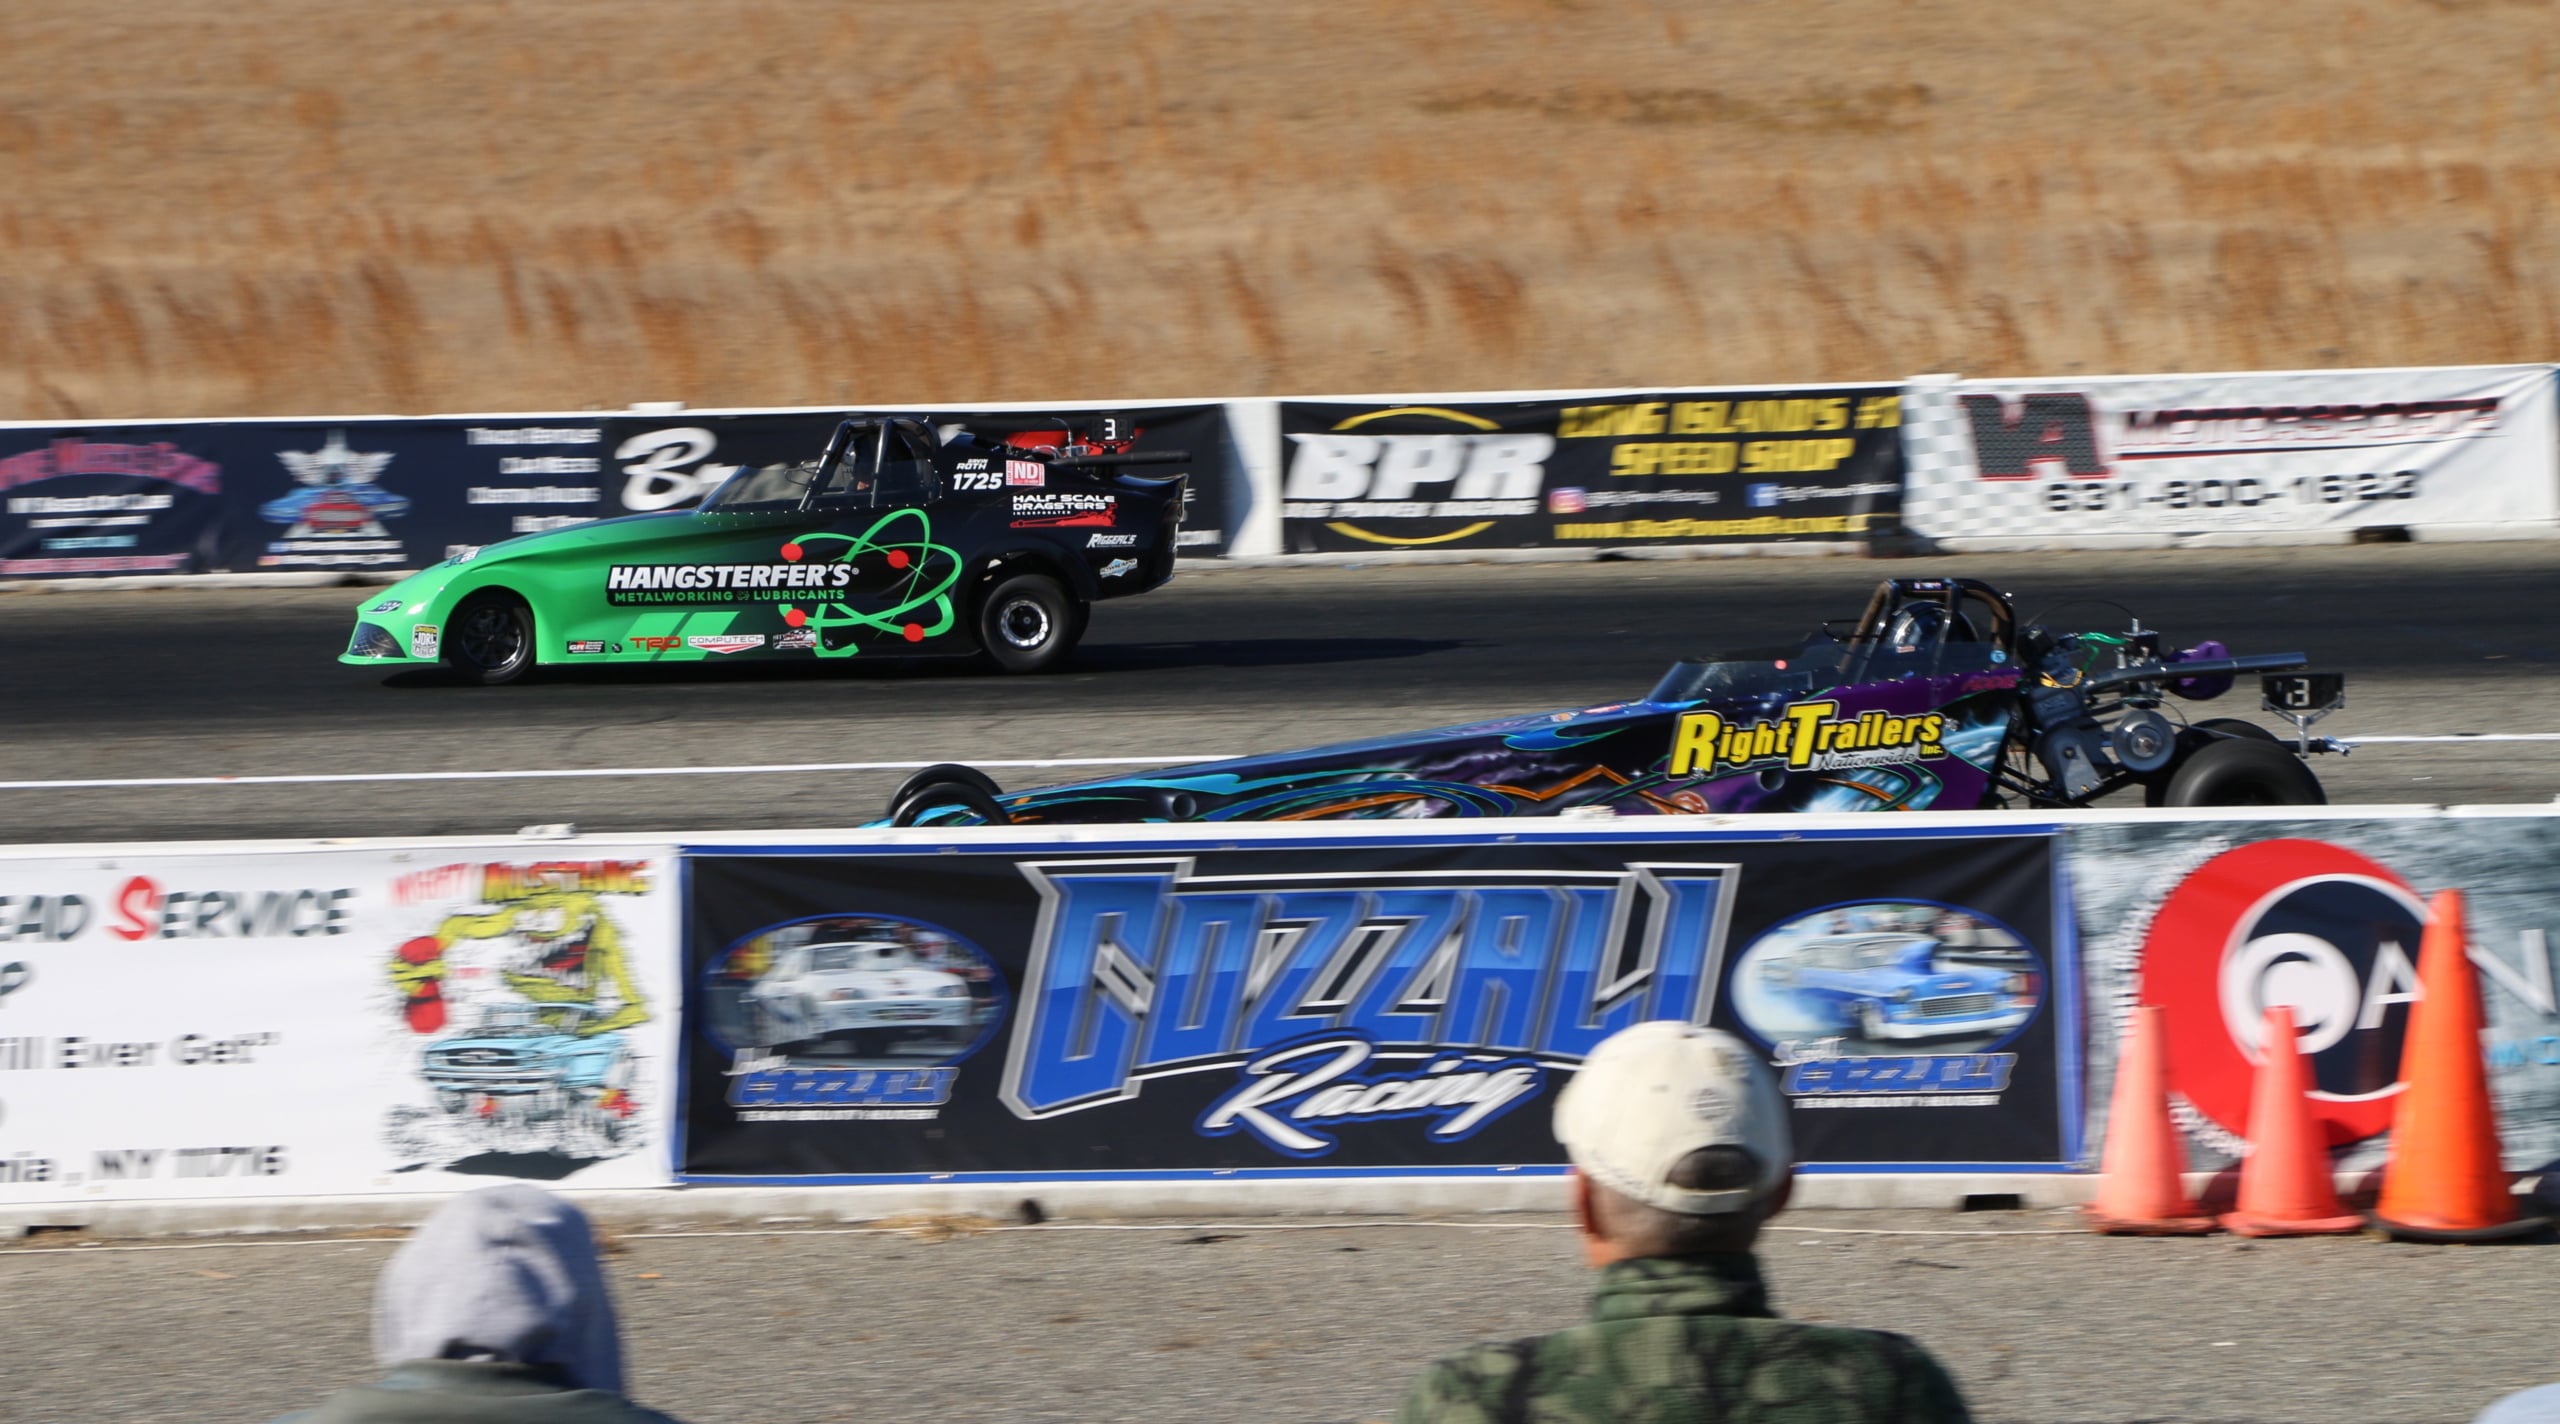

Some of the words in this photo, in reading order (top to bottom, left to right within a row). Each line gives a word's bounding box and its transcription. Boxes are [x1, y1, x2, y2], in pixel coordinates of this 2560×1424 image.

[1104, 418, 1116, 440] 3
[1284, 433, 1556, 500] BPR
[1609, 441, 1740, 476] SPEED
[1738, 438, 1855, 473] SHOP
[953, 472, 1004, 490] 1725
[1013, 495, 1056, 503] HALF
[1060, 494, 1115, 503] SCALE
[1013, 502, 1107, 511] DRAGSTERS
[615, 591, 734, 601] METALWORKING
[754, 589, 845, 600] LUBRICANTS
[629, 637, 681, 652] TRD
[689, 636, 765, 645] COMPUTECH
[1820, 751, 1918, 771] Nationwide
[108, 874, 356, 943] SERVICE
[56, 1036, 162, 1068] Ever
[1203, 1040, 1538, 1148] Racing
